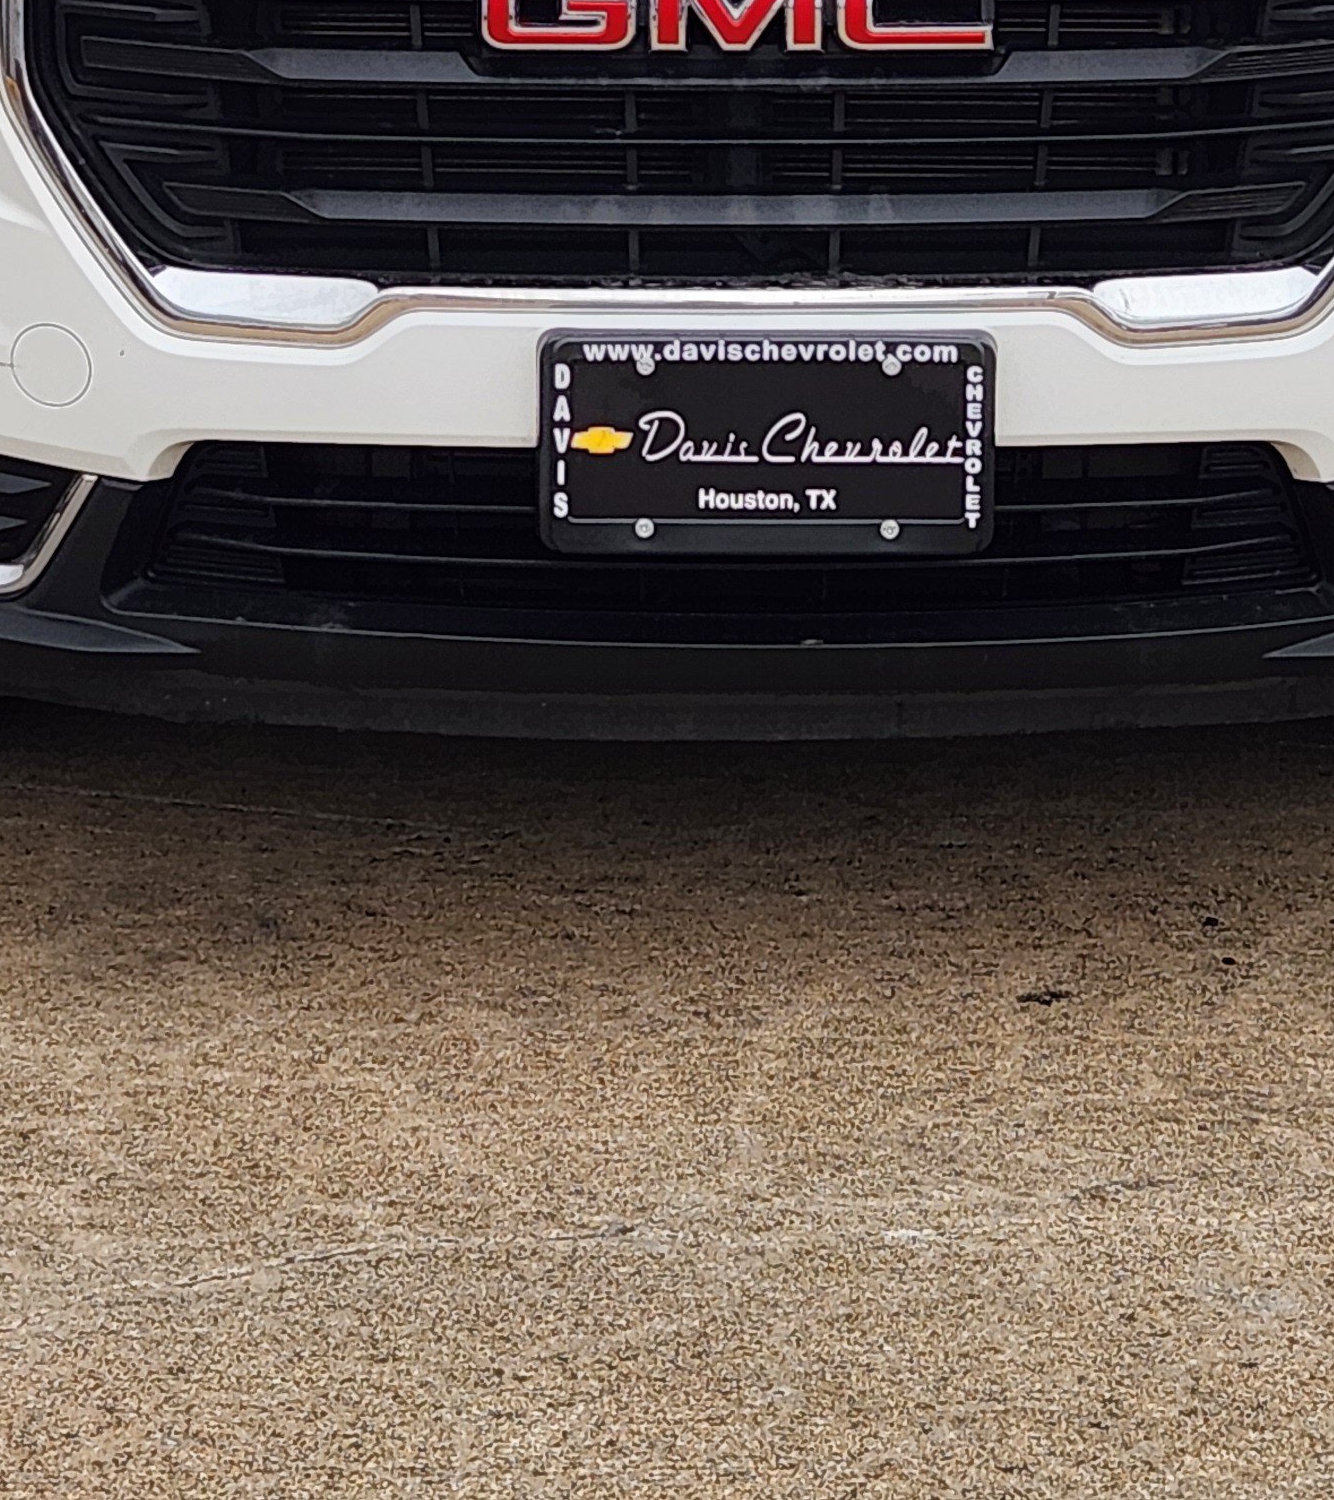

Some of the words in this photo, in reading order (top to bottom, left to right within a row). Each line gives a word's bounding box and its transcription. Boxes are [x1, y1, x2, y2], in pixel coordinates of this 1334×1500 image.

[582, 340, 958, 363] www.davischevrolet.com
[553, 364, 570, 519] DAVIS
[638, 410, 760, 462] Davis
[762, 412, 965, 463] Chevrolet
[964, 365, 985, 529] CHEVROLET
[698, 488, 801, 513] Houston,
[805, 488, 838, 510] TX
